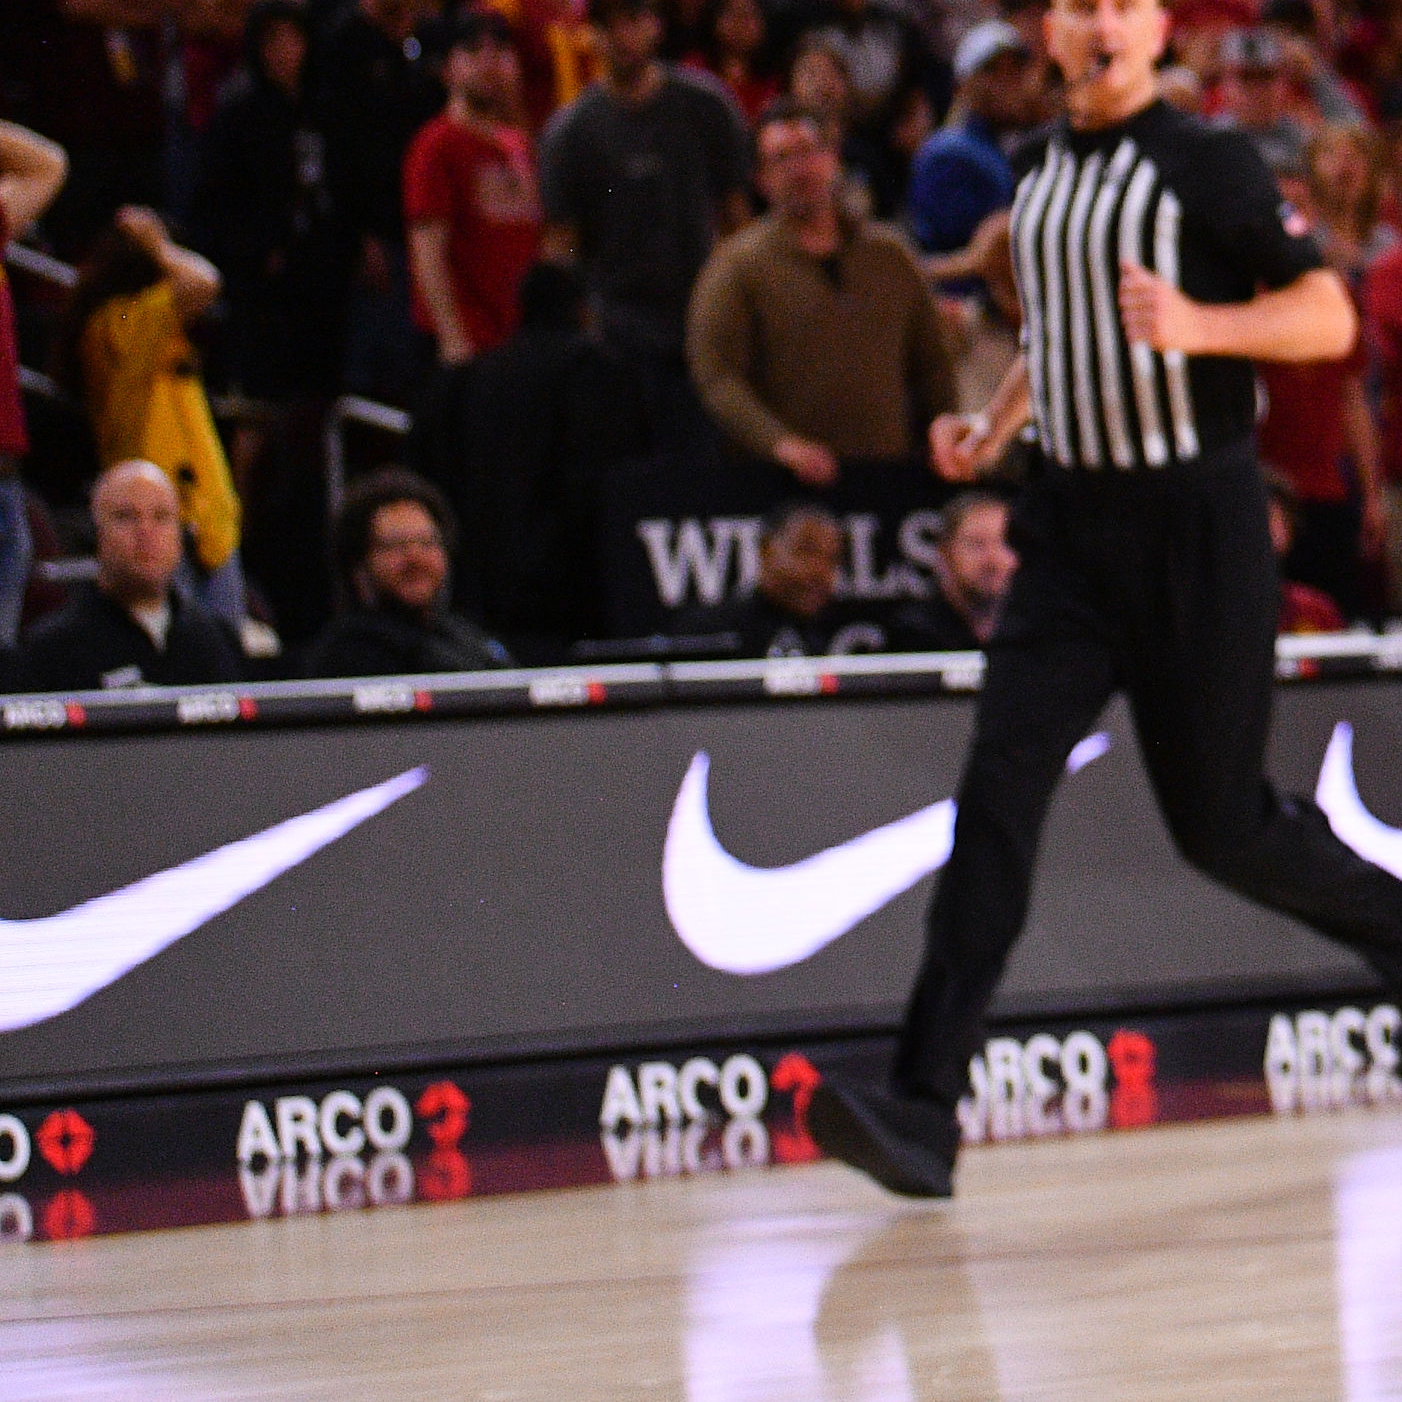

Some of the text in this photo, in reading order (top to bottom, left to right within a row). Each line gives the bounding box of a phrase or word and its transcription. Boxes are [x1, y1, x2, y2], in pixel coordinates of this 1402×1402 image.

[636, 510, 942, 606] WLS
[237, 1086, 412, 1162] ARCO
[600, 1054, 768, 1126] ARCO
